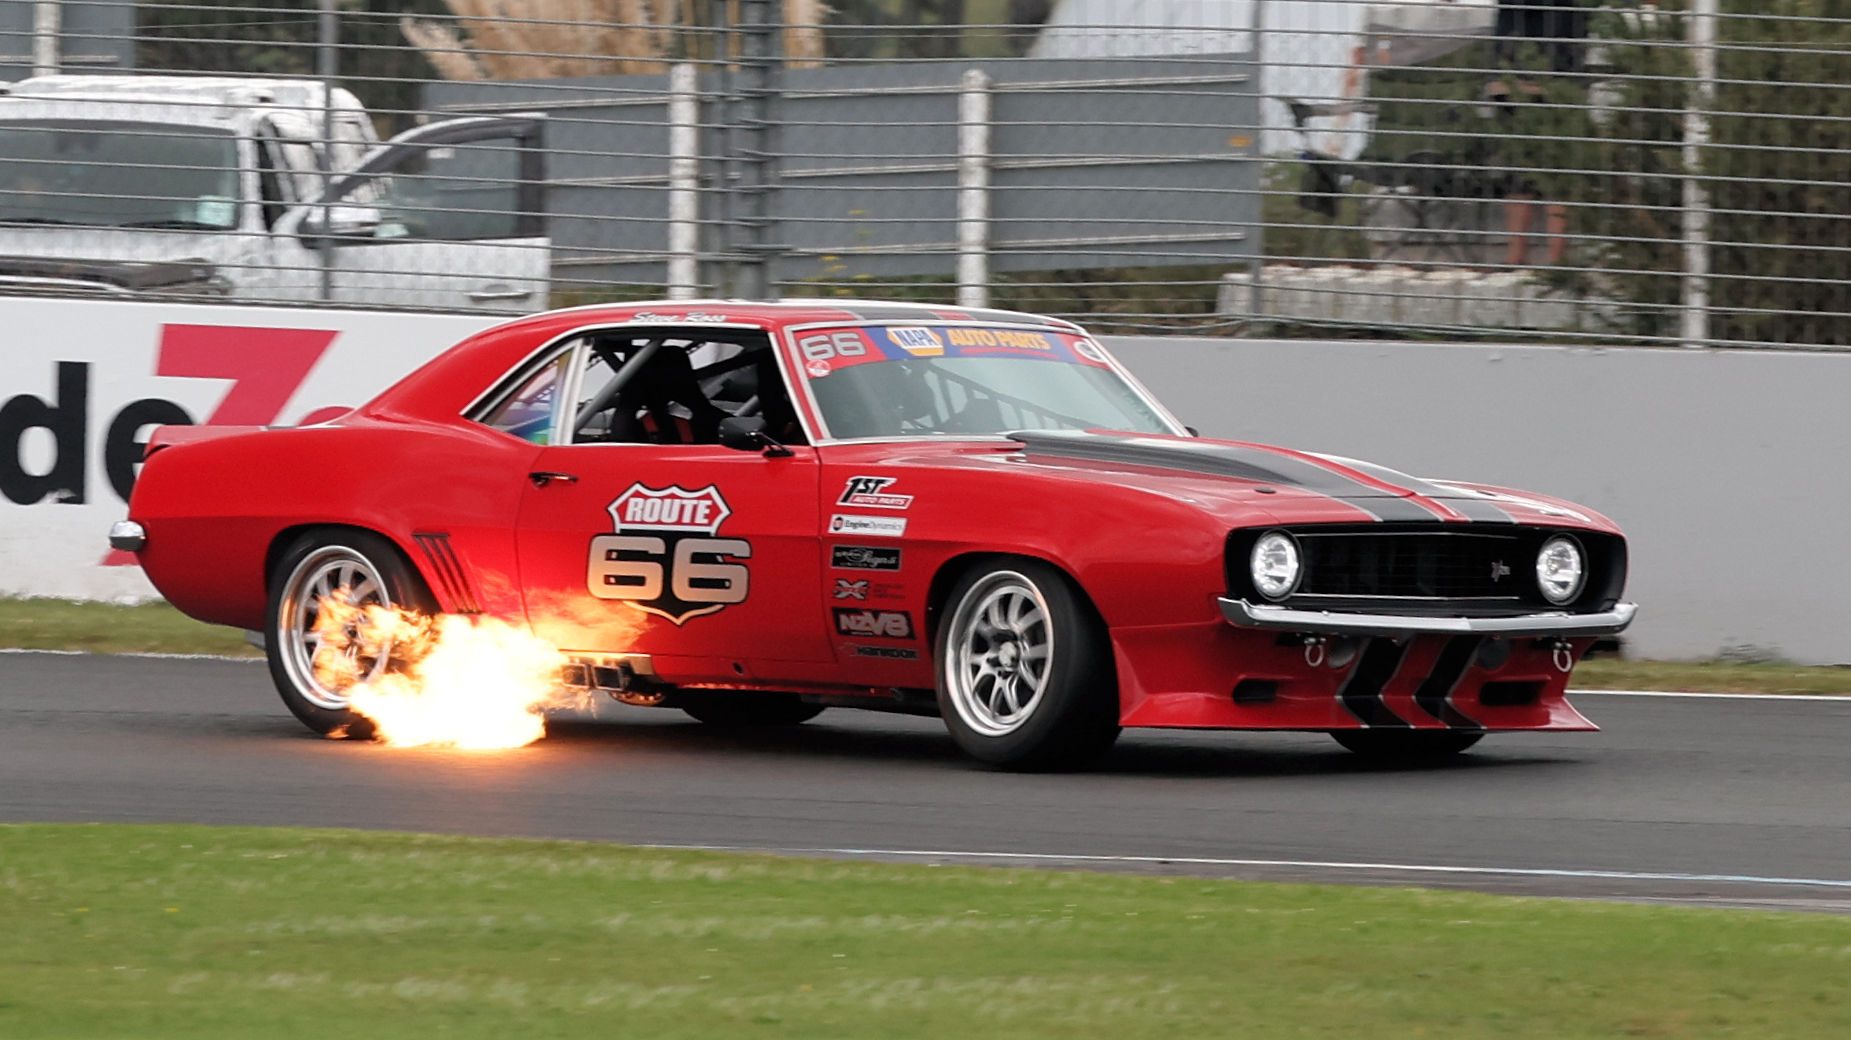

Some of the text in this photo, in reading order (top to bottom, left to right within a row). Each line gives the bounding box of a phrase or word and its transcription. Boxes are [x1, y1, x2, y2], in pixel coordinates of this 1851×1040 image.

[799, 331, 867, 361] 66
[892, 329, 941, 348] NAPA
[946, 328, 1052, 350] AUTO PARTS
[624, 497, 713, 524] ROUTE
[852, 495, 906, 506] AUTO PARTS
[586, 533, 752, 604] 66
[839, 611, 910, 638] NZV8
